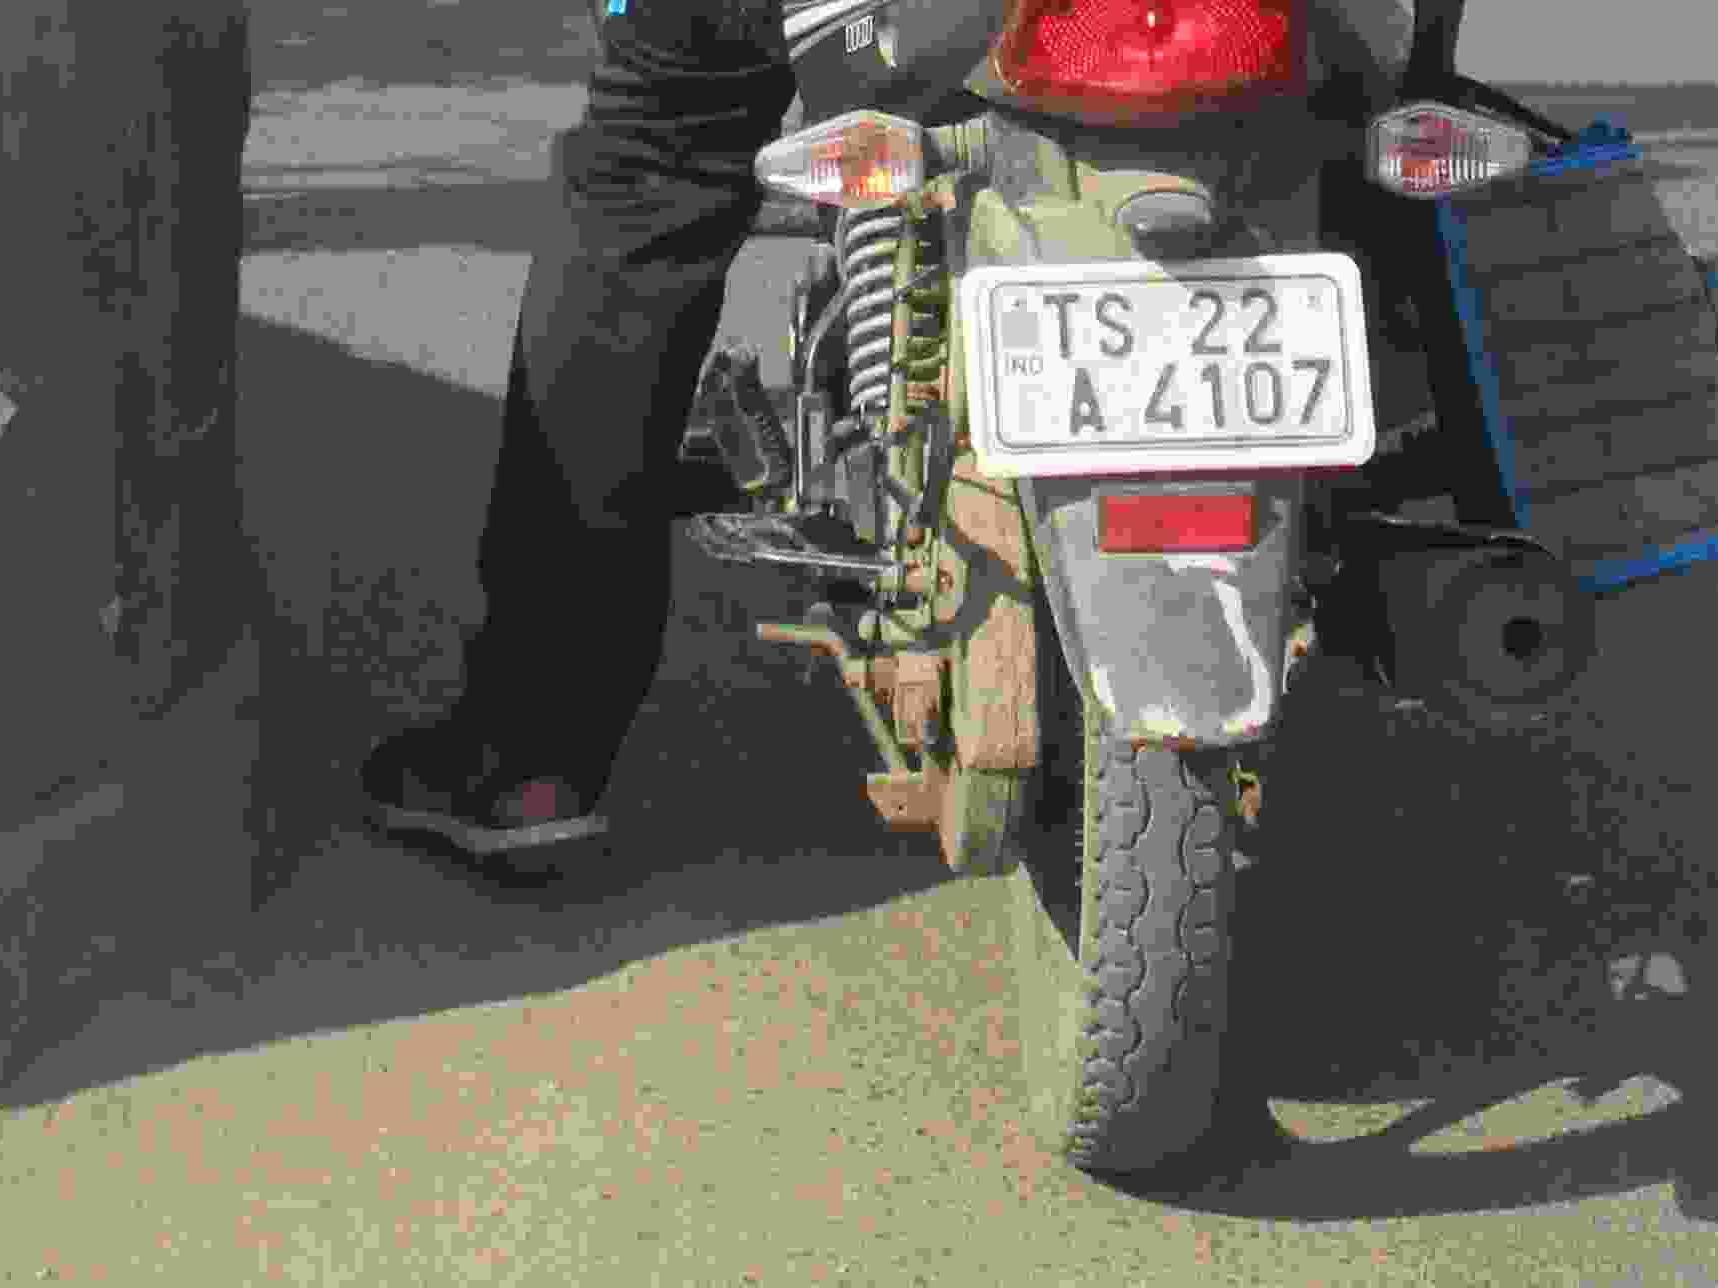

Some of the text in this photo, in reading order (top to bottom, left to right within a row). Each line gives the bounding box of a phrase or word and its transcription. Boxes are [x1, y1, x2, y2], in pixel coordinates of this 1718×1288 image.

[1041, 287, 1284, 360] TS 22
[1069, 357, 1333, 436] A 4107
